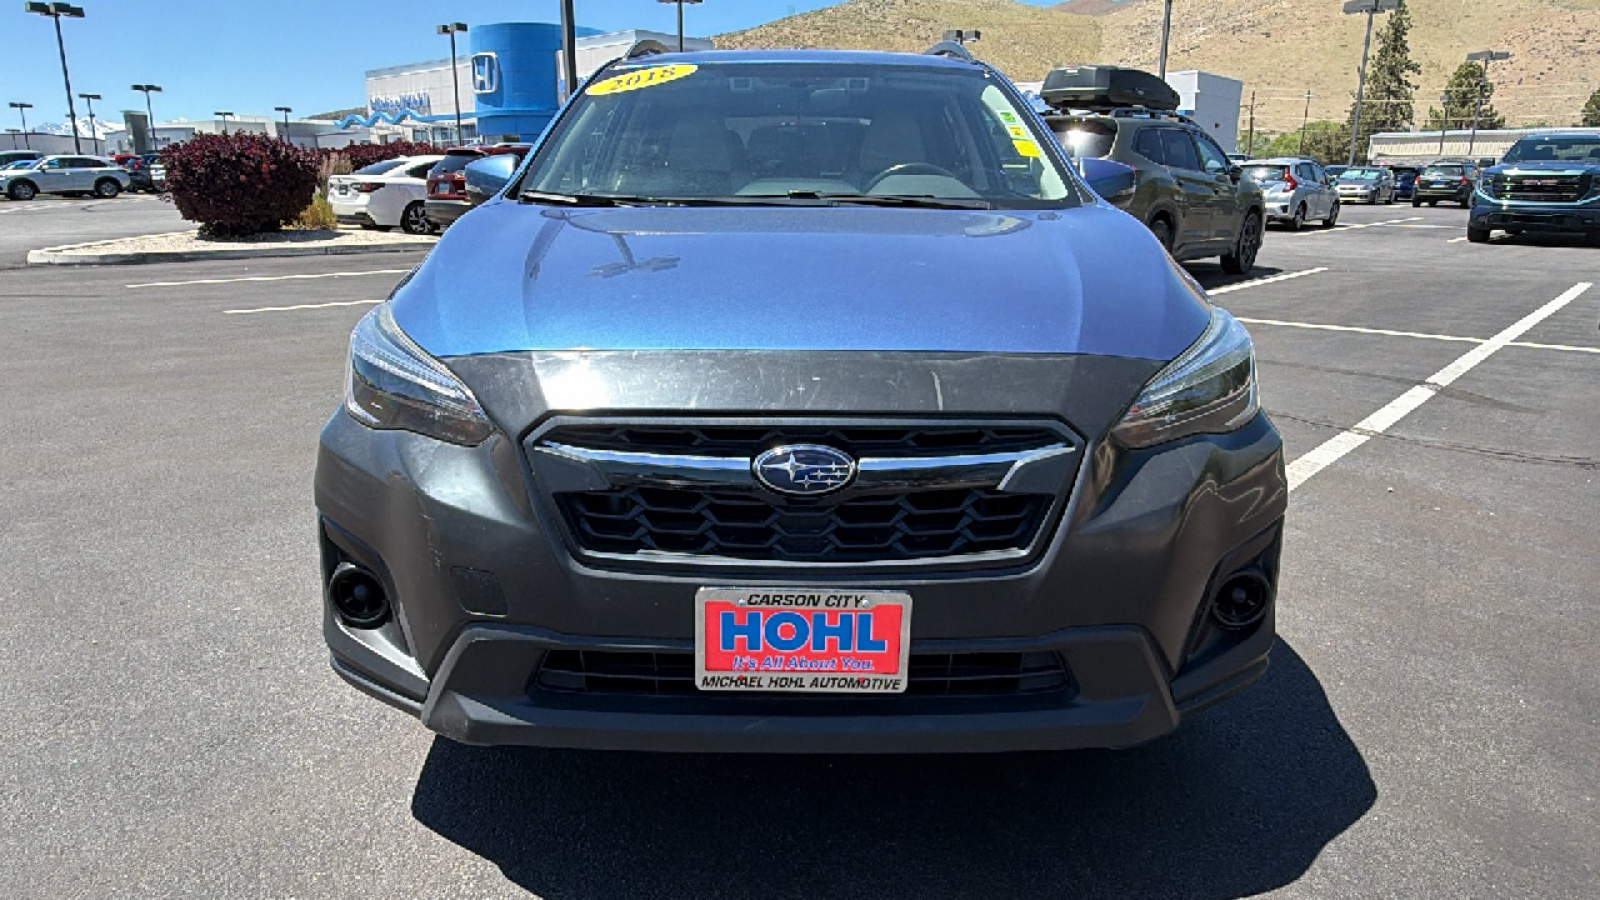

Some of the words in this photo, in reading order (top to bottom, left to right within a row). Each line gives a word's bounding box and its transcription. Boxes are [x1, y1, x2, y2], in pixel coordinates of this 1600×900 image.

[609, 66, 676, 91] 2018
[747, 594, 821, 606] CARSON
[825, 594, 866, 608] CITY
[720, 610, 887, 653] HOHL
[732, 655, 758, 670] It's
[760, 655, 784, 670] All
[786, 655, 837, 670] About
[840, 656, 875, 670] You.
[701, 675, 763, 688] MICHAEL
[767, 677, 806, 688] HOHL
[809, 677, 902, 690] AUTOMOTIVE
